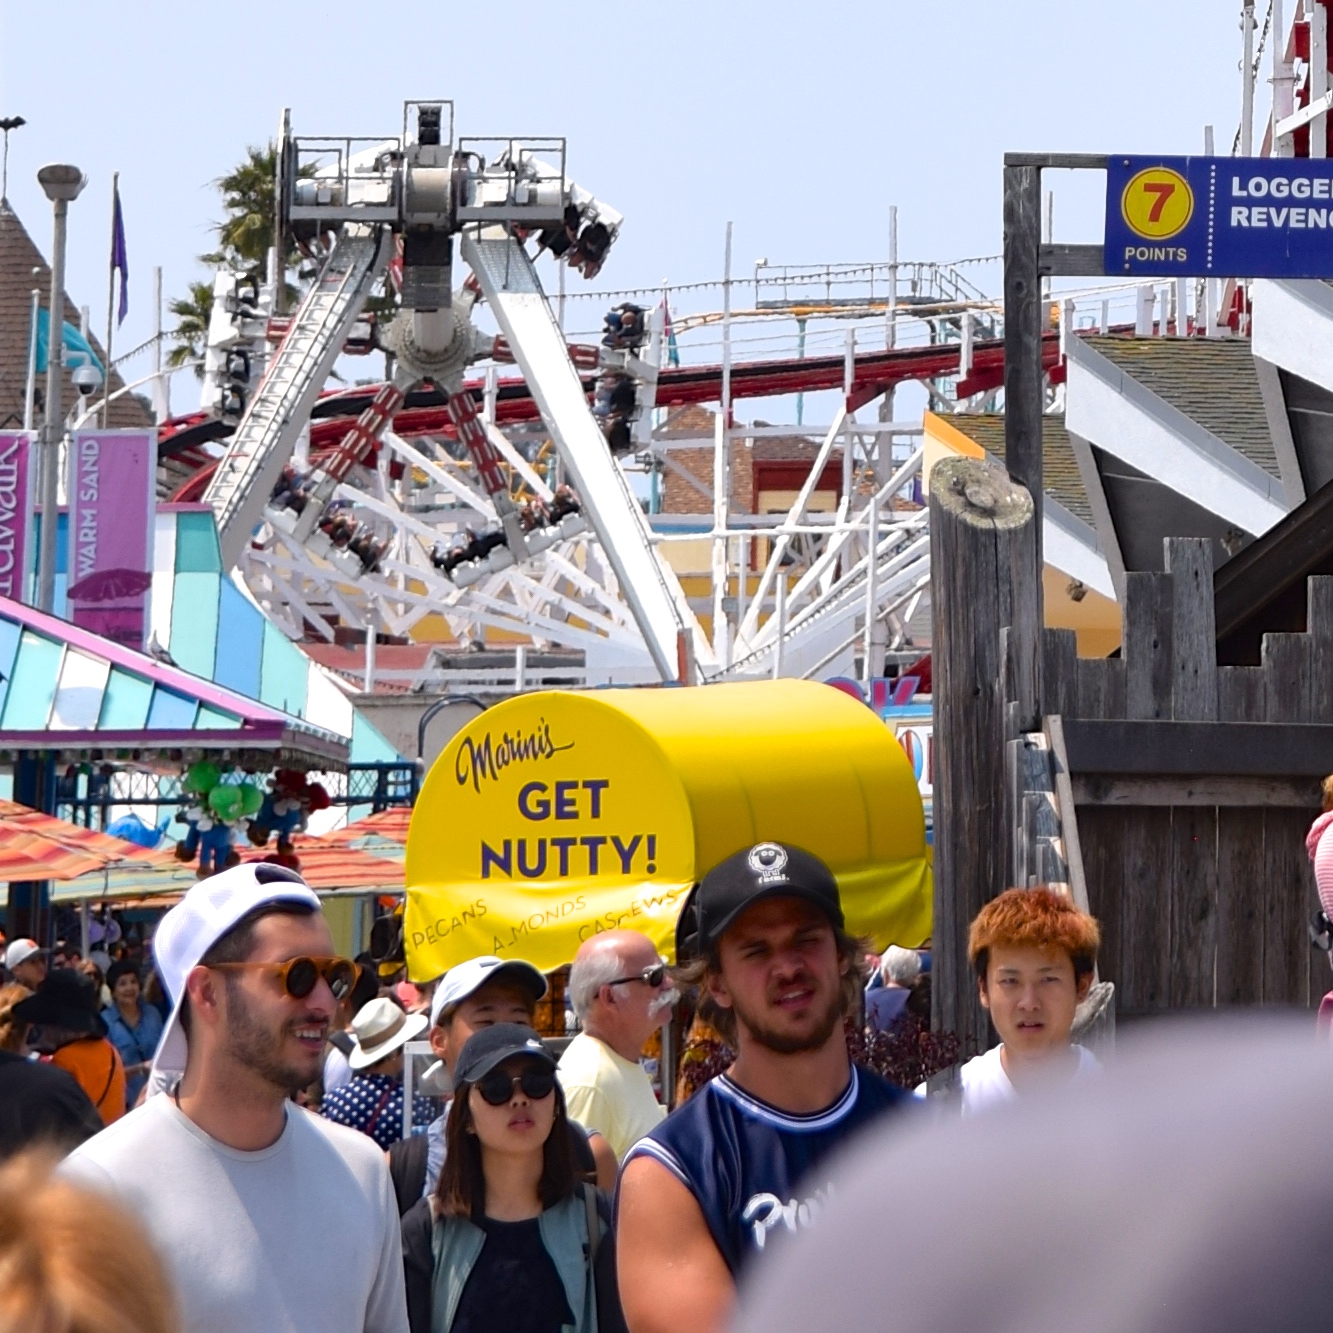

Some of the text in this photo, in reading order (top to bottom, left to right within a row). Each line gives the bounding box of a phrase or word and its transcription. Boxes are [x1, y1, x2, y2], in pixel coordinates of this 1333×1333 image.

[1143, 183, 1176, 224] 7
[1124, 247, 1188, 262] POINTS
[78, 439, 100, 577] WARM SAND
[455, 717, 575, 794] Marini's
[517, 779, 609, 822] GET
[480, 834, 658, 879] NUTTY!
[411, 898, 489, 951] PECANS
